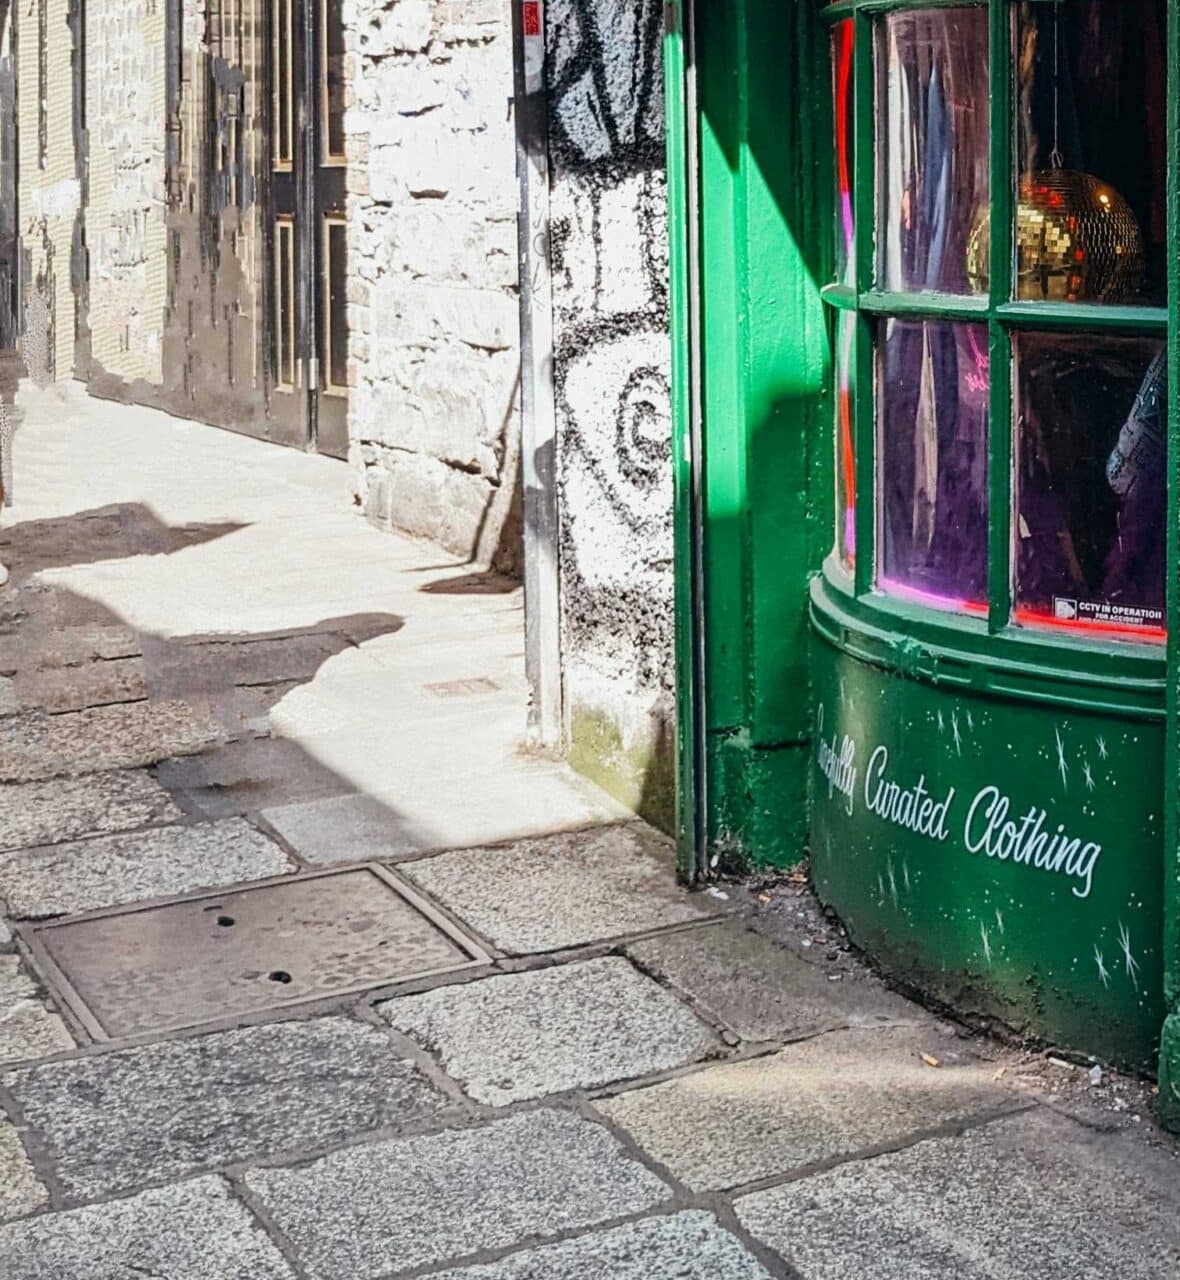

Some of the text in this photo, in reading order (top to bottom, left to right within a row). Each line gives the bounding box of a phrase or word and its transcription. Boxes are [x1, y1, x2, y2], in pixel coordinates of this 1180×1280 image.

[1078, 601, 1162, 620] CCTV IN OPERATION
[864, 745, 956, 841] Curated
[964, 785, 1102, 897] Clothing
